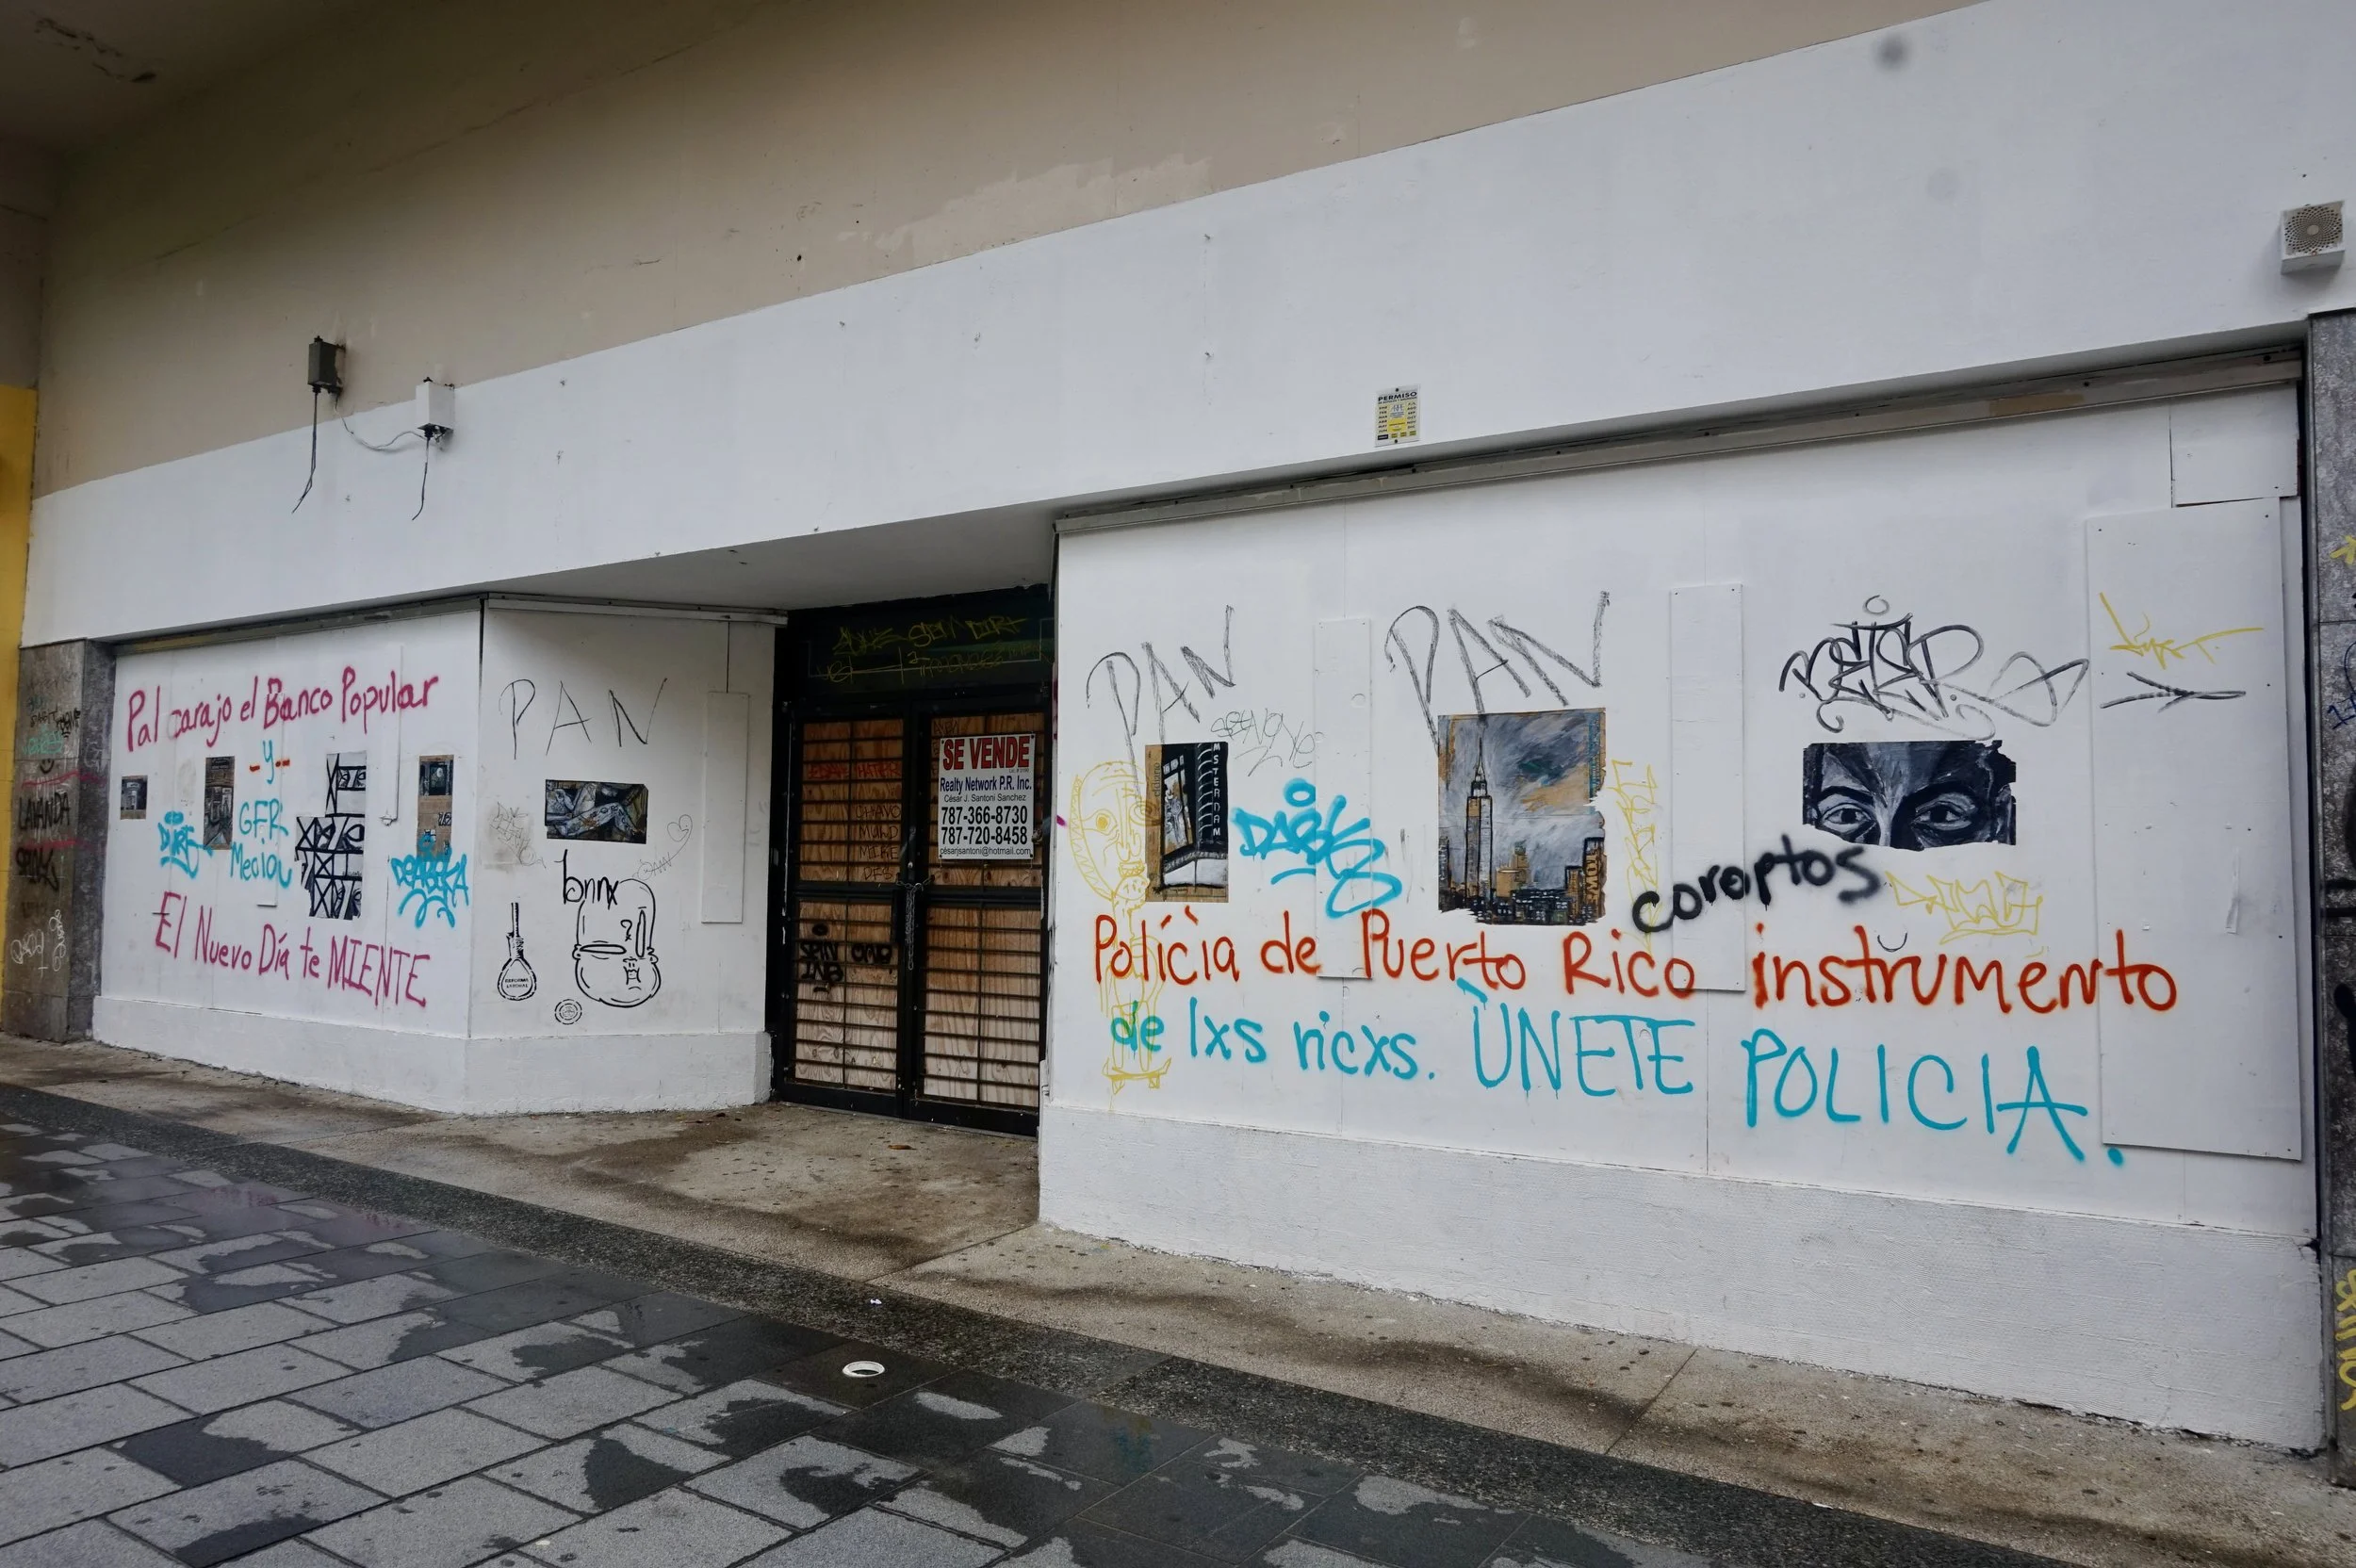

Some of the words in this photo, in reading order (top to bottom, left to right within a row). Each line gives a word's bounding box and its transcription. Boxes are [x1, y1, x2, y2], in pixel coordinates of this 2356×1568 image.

[1378, 391, 1417, 401] PERMISO
[1384, 590, 1611, 756] PAN
[127, 685, 160, 752] Pal
[239, 675, 259, 723] el
[263, 678, 334, 730] Banco
[342, 665, 440, 735] Popular
[499, 677, 668, 760] PAN
[1086, 604, 1237, 799] PAN
[942, 738, 965, 771] SE
[969, 736, 1030, 770] VENDE
[941, 777, 963, 795] Realty
[965, 776, 997, 791] Network
[1000, 776, 1014, 791] P.R.
[1018, 776, 1032, 790] Inc.
[944, 794, 962, 803] César
[972, 793, 995, 802] Santoni
[998, 793, 1026, 802] Sanchez
[18, 792, 71, 830] LAVANDA
[239, 798, 288, 840] GFR
[941, 806, 1027, 825] 787-366-8730
[941, 826, 1027, 845] 787-720-8458
[155, 891, 188, 959] El
[194, 905, 253, 971] Nuevo
[257, 923, 290, 981] Día
[300, 926, 320, 979] te
[327, 935, 431, 1007] MIENTE
[1260, 910, 1322, 974] de
[1360, 909, 1527, 992] Puerto
[1562, 926, 1696, 999] Rico
[1751, 923, 2178, 1013] instrumento
[1110, 1000, 1165, 1055] de
[1189, 996, 1268, 1063] lxs
